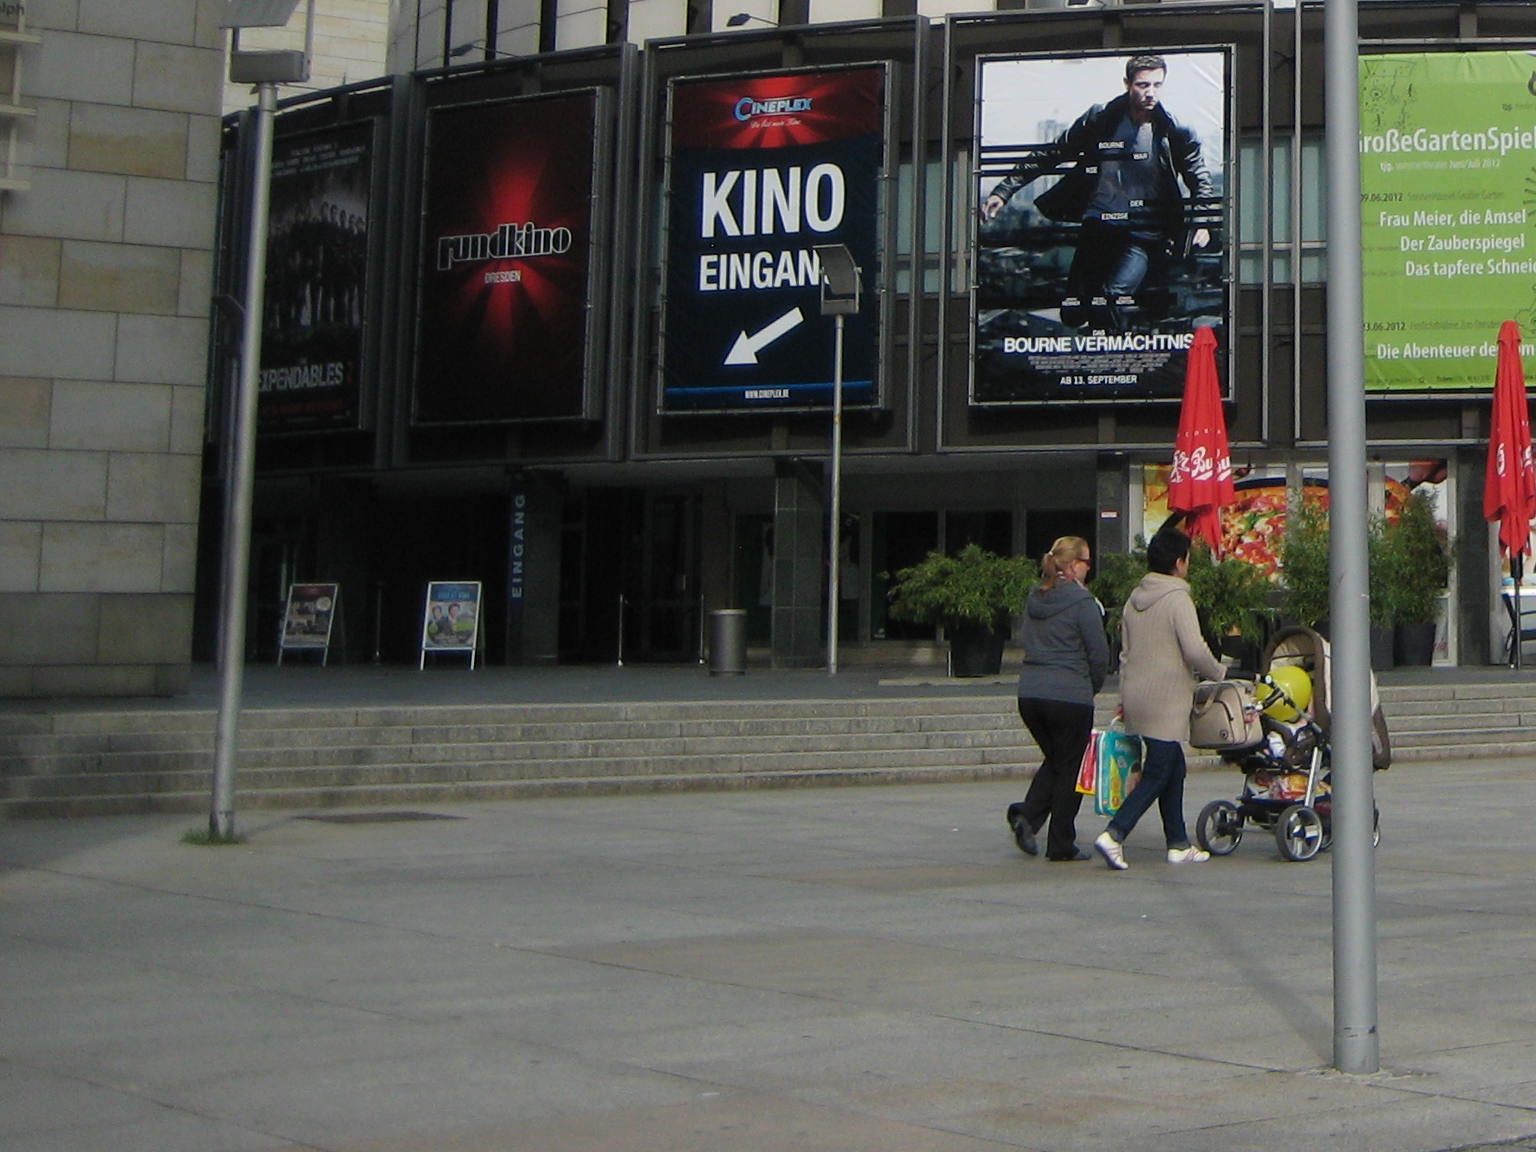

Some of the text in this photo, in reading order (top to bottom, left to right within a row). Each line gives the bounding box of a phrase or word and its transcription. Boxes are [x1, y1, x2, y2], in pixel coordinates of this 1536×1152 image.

[734, 97, 813, 122] CINEPLEX
[1098, 141, 1125, 150] BOURNE
[701, 162, 846, 239] KINO
[1129, 199, 1144, 208] DER
[1379, 208, 1527, 228] Frau Meier, die Amsel
[436, 221, 573, 272] rundkino
[1400, 233, 1526, 253] Der Zauberspiegel
[699, 249, 831, 291] EINGAN
[1405, 260, 1430, 277] Das
[1434, 259, 1484, 279] tapfere
[1003, 331, 1195, 354] BOURNE VERMÄCHTNIS
[1377, 343, 1400, 360] Die
[1402, 342, 1476, 359] Abenteuer
[1479, 341, 1500, 358] de
[1059, 376, 1072, 385] AB
[1087, 374, 1138, 385] SEPTEMBER
[511, 493, 527, 599] EINGANG
